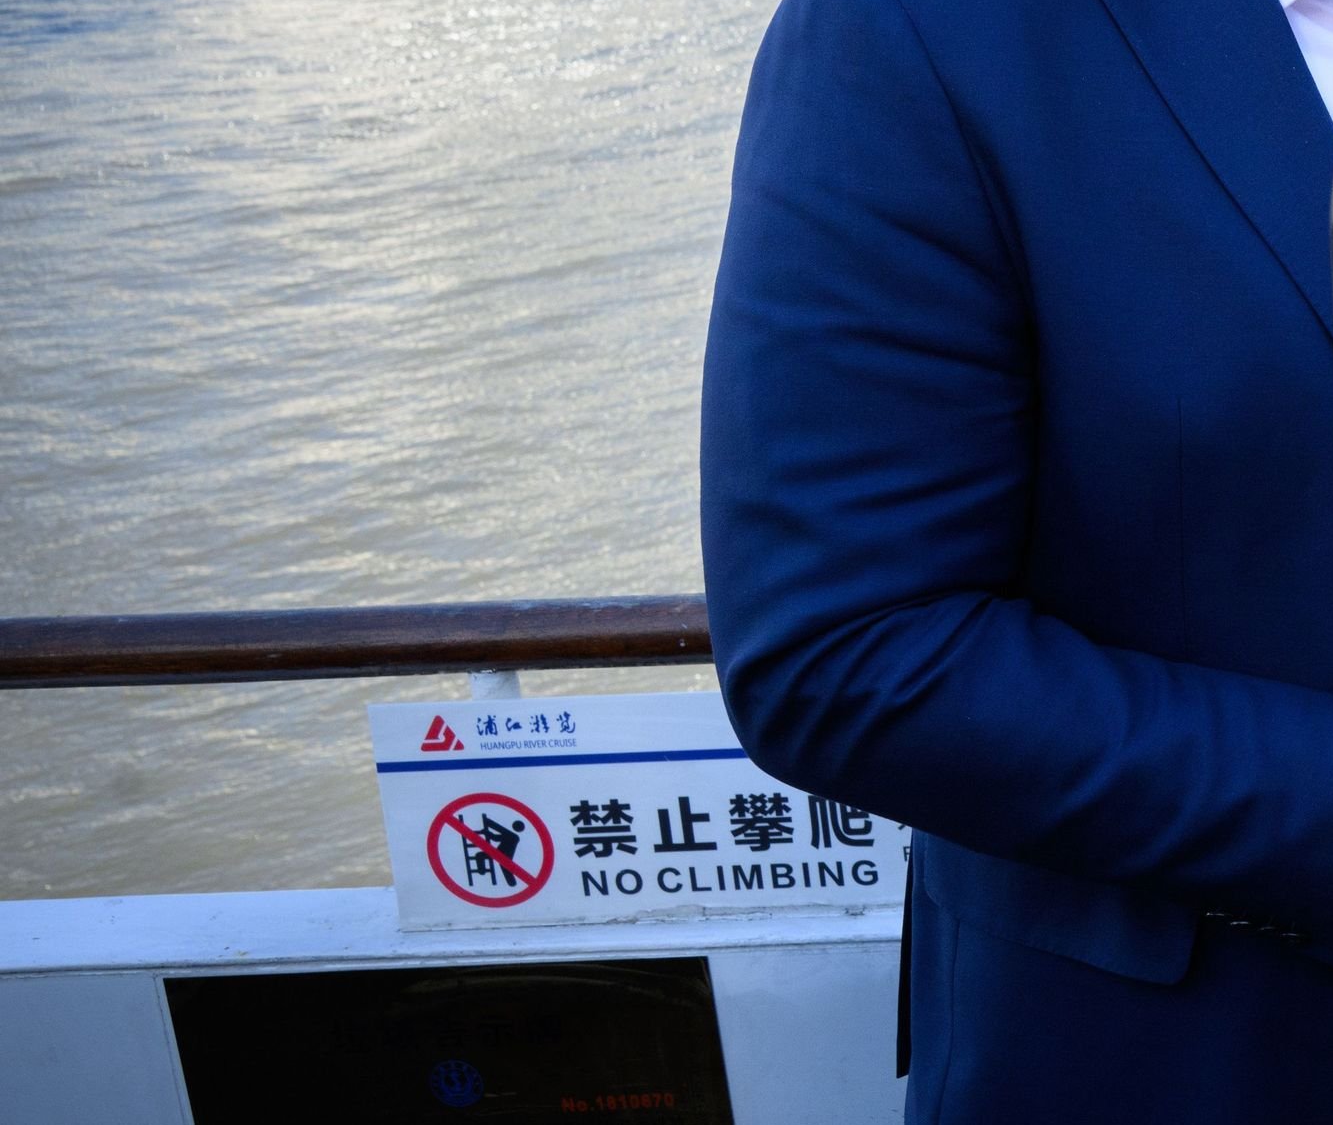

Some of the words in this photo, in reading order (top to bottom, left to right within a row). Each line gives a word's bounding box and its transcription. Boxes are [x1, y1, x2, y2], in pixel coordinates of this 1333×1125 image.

[480, 740, 521, 751] HUANGPU
[523, 739, 547, 749] RIVER
[548, 738, 577, 748] CRUISE
[569, 792, 875, 859] 禁止攀爬
[581, 868, 643, 897] NO
[657, 859, 879, 893] CLIMBING
